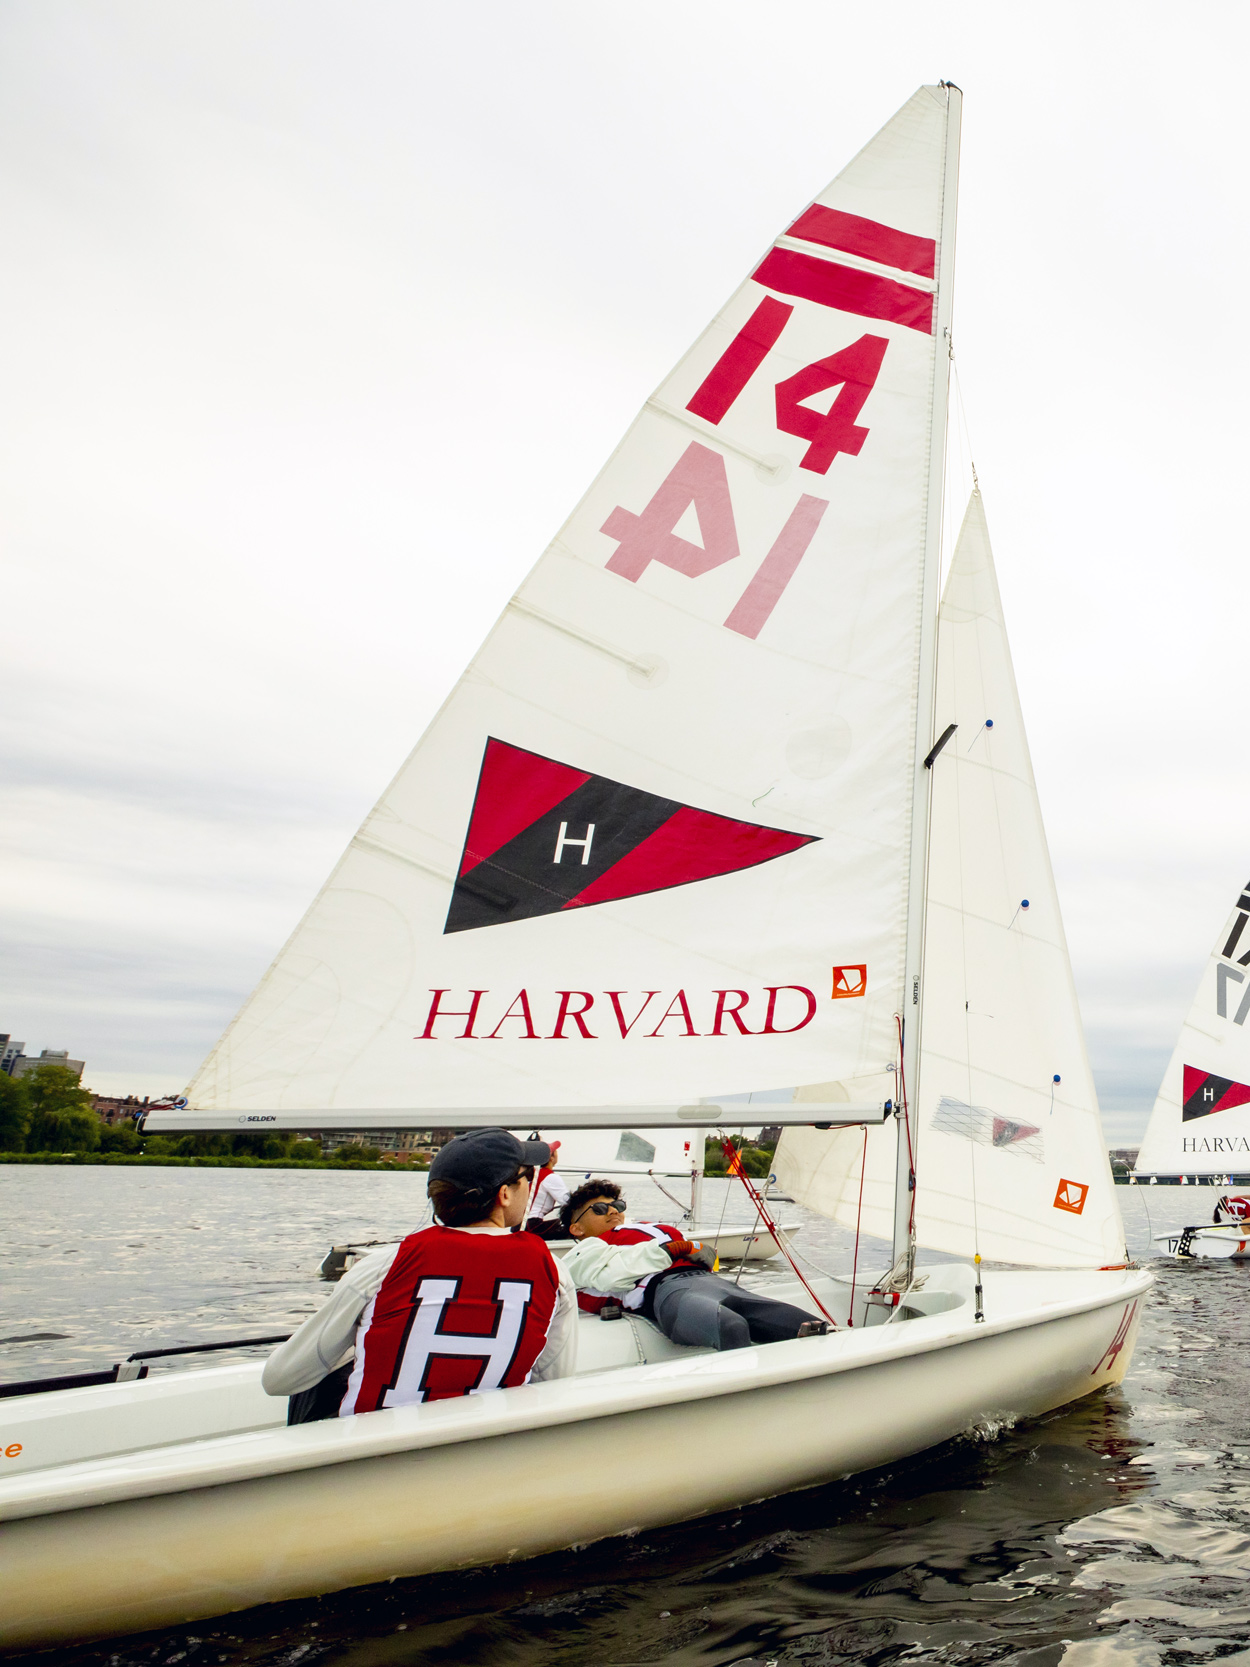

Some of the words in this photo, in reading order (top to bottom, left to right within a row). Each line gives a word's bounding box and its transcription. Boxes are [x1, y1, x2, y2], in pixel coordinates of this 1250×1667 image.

[685, 294, 890, 476] 14
[553, 821, 595, 865] H
[413, 985, 818, 1040] HARVARD
[1203, 1087, 1214, 1102] H
[1168, 1239, 1179, 1253] 17
[380, 1277, 534, 1410] H
[1091, 1299, 1138, 1375] 14
[0, 1443, 23, 1458] e
